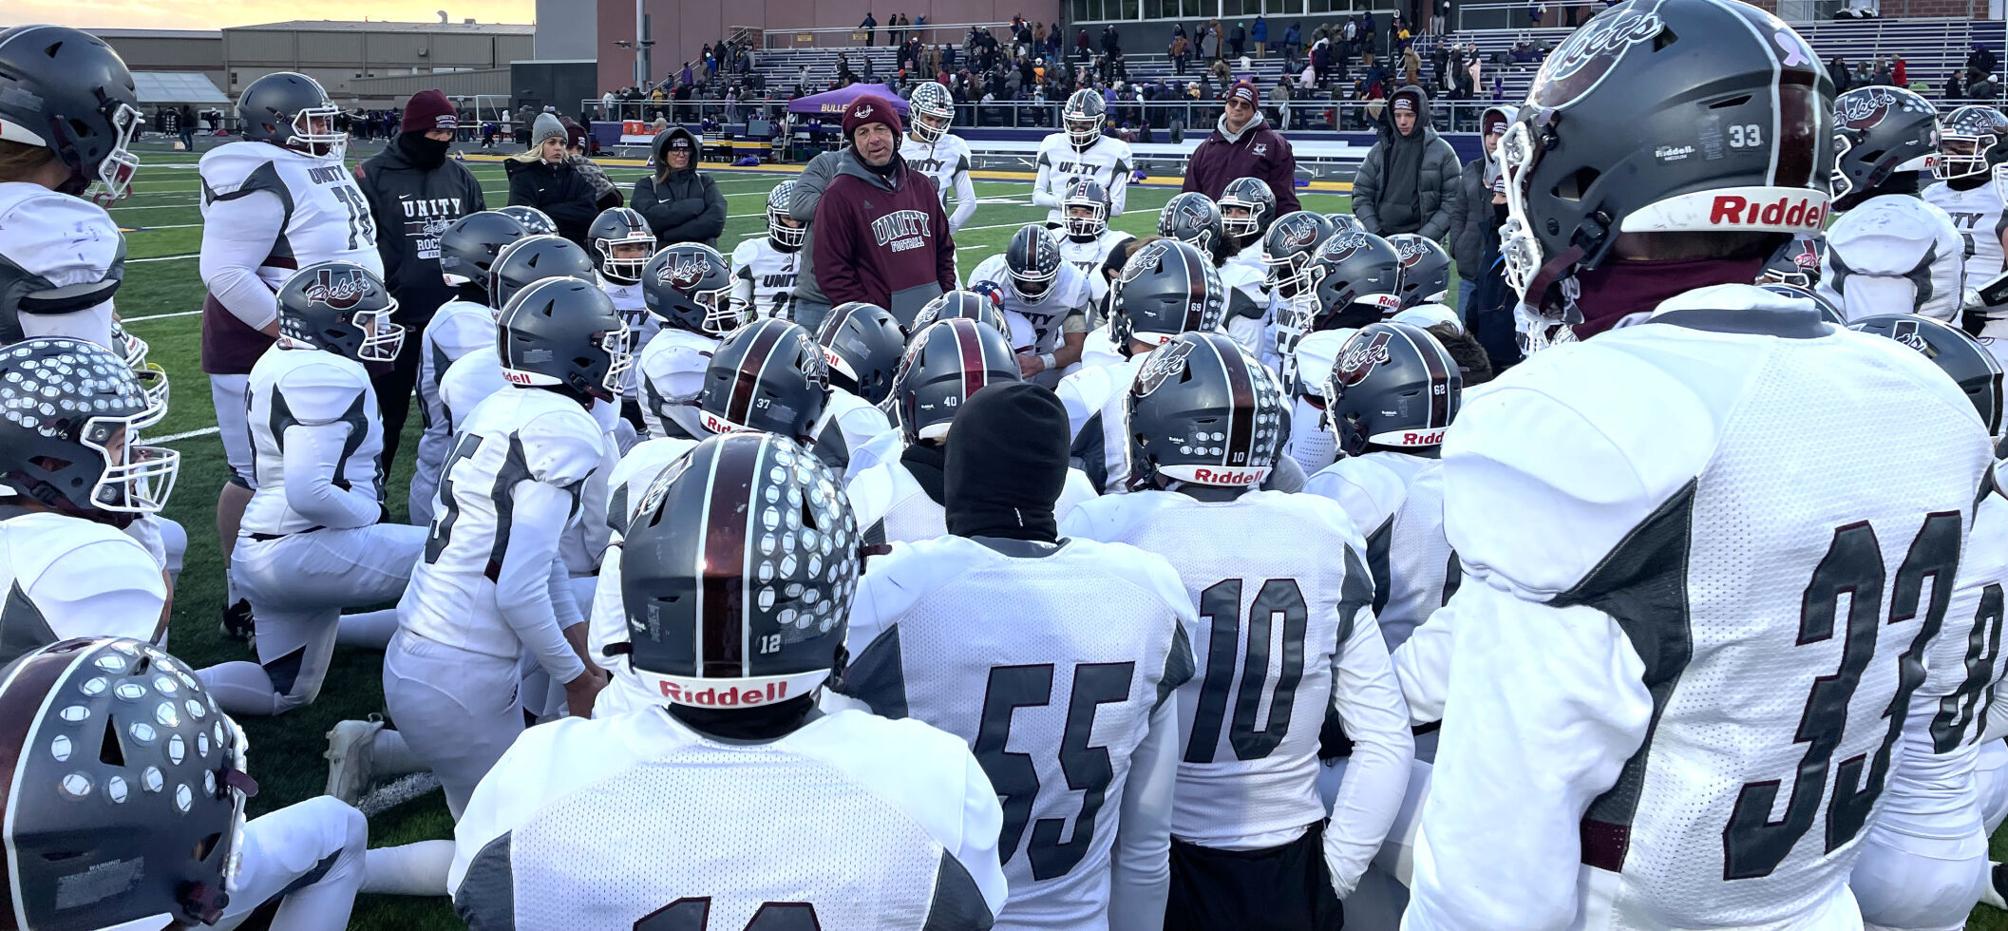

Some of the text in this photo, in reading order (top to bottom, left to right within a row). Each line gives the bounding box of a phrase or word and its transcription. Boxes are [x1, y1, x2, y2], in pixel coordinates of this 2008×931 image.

[1728, 124, 1761, 147] 33
[307, 165, 346, 184] UNITY
[402, 198, 460, 217] UNITY
[1710, 195, 1829, 230] Riddell
[871, 210, 931, 247] UNITY
[891, 236, 925, 252] FOOTBALL
[657, 259, 711, 286] Rockets
[306, 278, 370, 307] Rockets
[1190, 303, 1202, 312] 69
[1433, 384, 1446, 396] 62
[756, 398, 770, 409] 37
[943, 396, 957, 407] 40
[1402, 431, 1444, 445] Ridd
[1232, 452, 1245, 463] 10
[1195, 469, 1265, 484] Riddell
[760, 634, 781, 654] 12
[1184, 579, 1308, 763] 10
[659, 680, 788, 706] Riddell
[1723, 510, 1962, 881] 33
[972, 661, 1136, 882] 55
